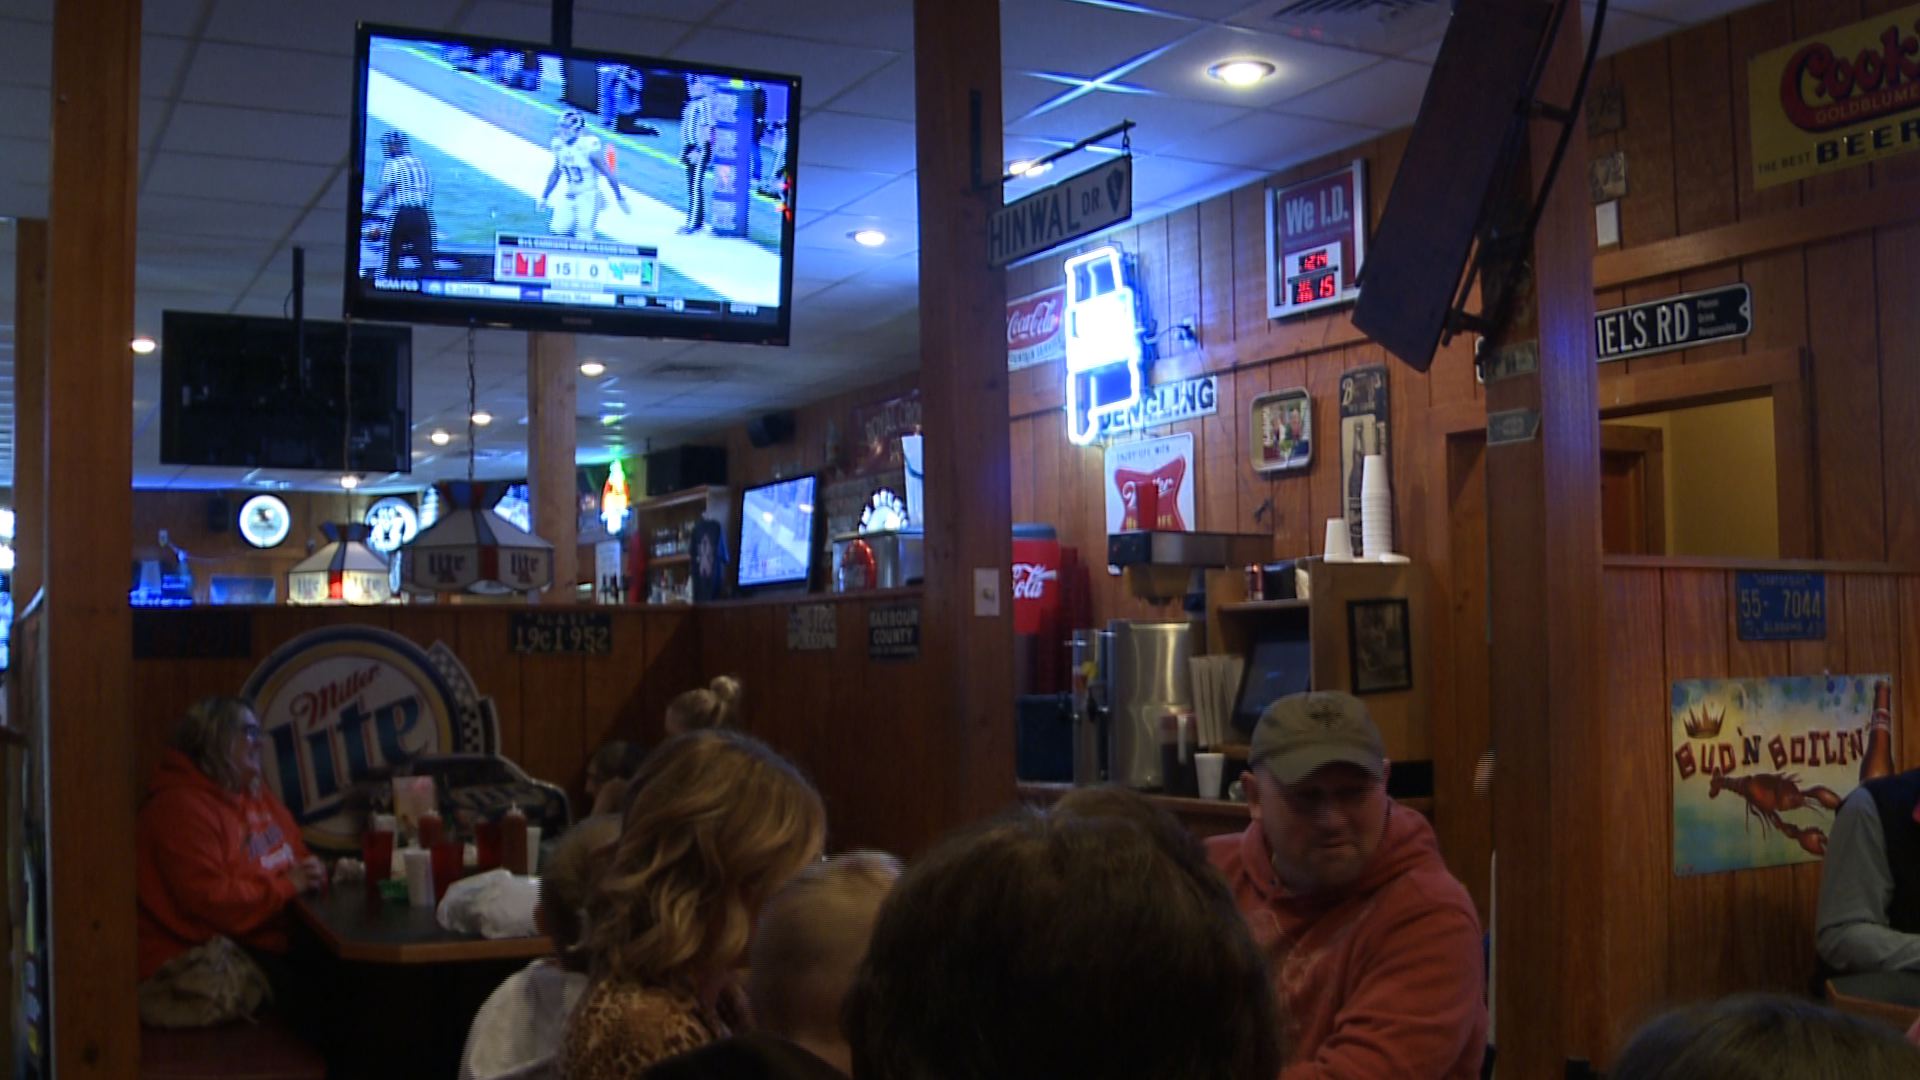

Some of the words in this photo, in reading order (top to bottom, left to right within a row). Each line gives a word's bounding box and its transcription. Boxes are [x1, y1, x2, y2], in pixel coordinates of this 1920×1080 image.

[1781, 24, 1920, 132] Cook
[1286, 196, 1314, 236] We
[1320, 185, 1349, 227] I.D.
[555, 262, 571, 276] 15
[1598, 309, 1648, 355] IEL'S
[1657, 302, 1690, 345] RD
[873, 628, 913, 645] COUNTY
[289, 664, 381, 730] Miller
[268, 693, 430, 828] Lite
[1675, 741, 1737, 780] BUD
